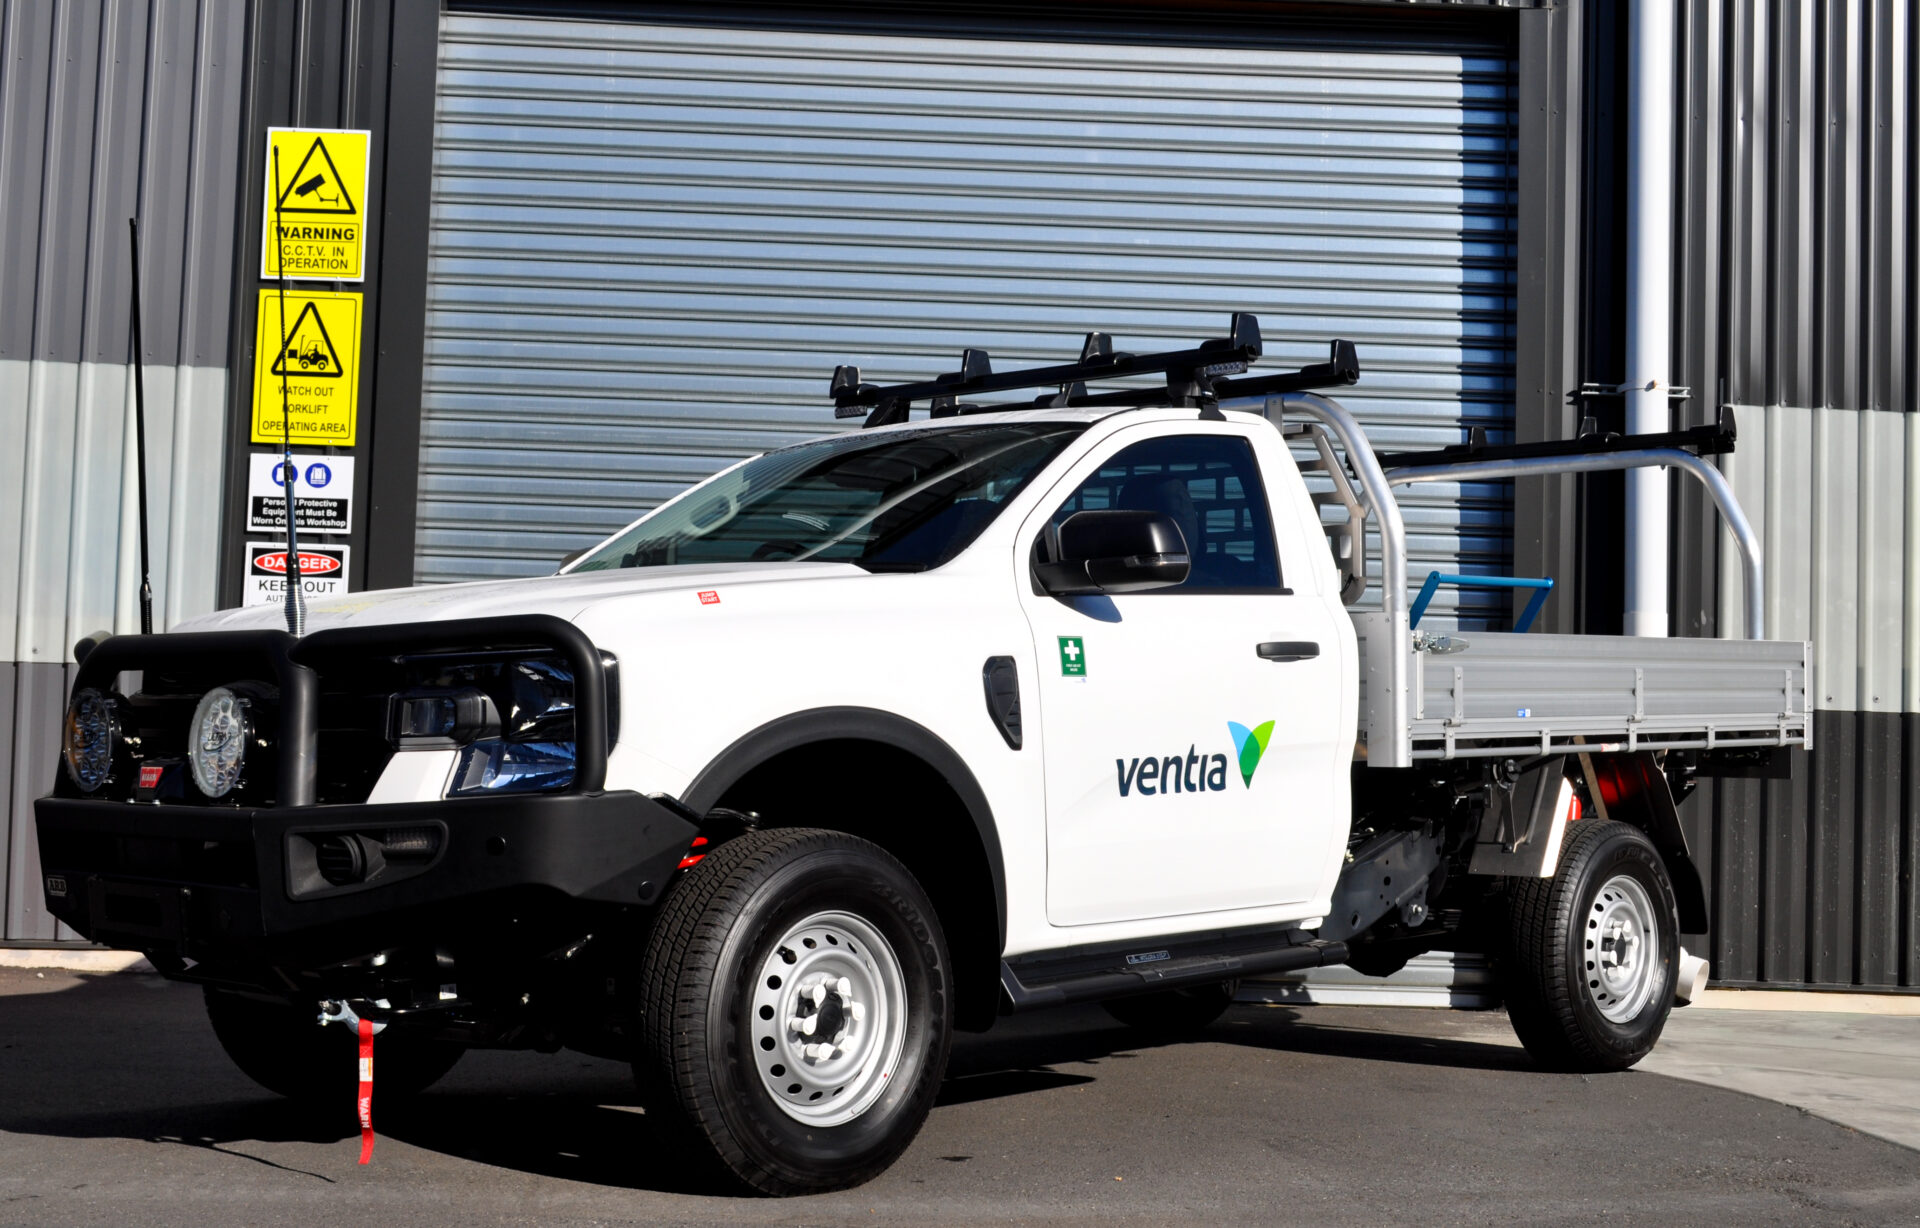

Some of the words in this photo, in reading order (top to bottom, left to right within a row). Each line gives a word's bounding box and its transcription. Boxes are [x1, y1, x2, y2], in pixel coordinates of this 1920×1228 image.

[276, 226, 355, 240] WARNING
[282, 245, 326, 256] C.C.T.V.
[332, 246, 345, 257] IN
[279, 257, 348, 270] OPERATION
[278, 385, 311, 396] WATCH
[314, 386, 334, 397] OUT
[320, 422, 346, 433] AREA
[263, 498, 297, 506] Persol
[299, 499, 337, 508] Protective
[263, 508, 304, 516] Equipnt
[306, 509, 325, 517] Must
[326, 509, 337, 517] Be
[253, 517, 273, 525] Worn
[306, 518, 346, 528] Workshop
[264, 556, 331, 569] DAGER
[258, 580, 291, 591] KEE
[304, 581, 336, 593] OUT
[1116, 744, 1228, 797] ventia
